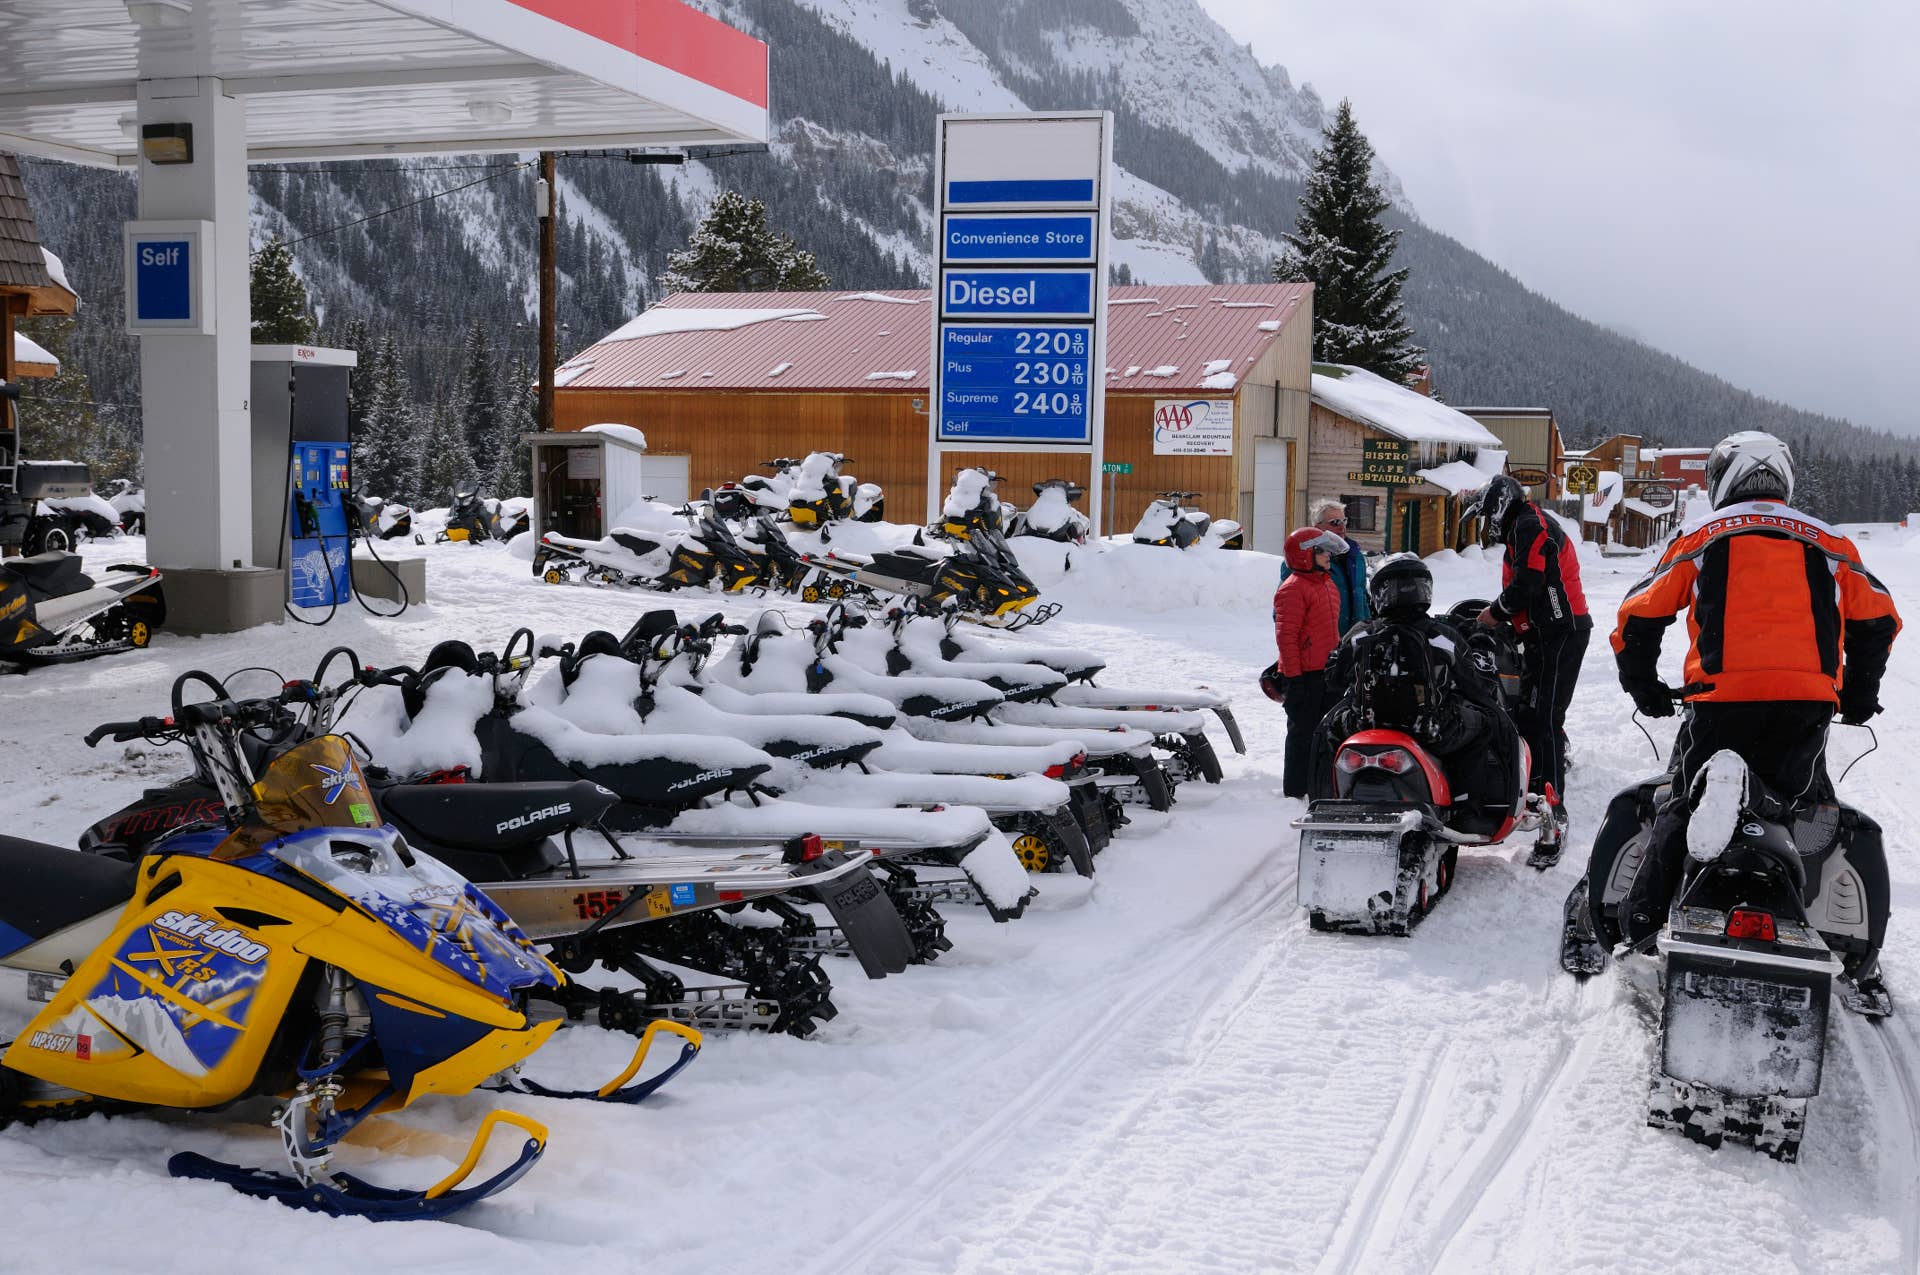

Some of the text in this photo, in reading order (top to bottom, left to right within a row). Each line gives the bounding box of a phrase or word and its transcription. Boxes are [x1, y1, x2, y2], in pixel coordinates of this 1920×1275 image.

[951, 231, 1084, 245] Convenience Store
[142, 248, 180, 266] Self
[949, 280, 1036, 305] Diesel
[948, 332, 993, 346] Regular
[1014, 332, 1070, 355] 220
[297, 348, 315, 359] EXXON
[947, 362, 972, 373] Plus
[1013, 362, 1069, 385] 230
[243, 400, 248, 410] 2
[946, 392, 999, 405] Supreme
[1013, 392, 1069, 415] 240
[1157, 404, 1190, 431] AAA
[946, 420, 969, 432] Self
[1376, 441, 1399, 450] THE
[1365, 451, 1409, 461] BISTRO
[1102, 463, 1121, 473] ATON
[1369, 464, 1404, 473] CAFE
[1349, 472, 1424, 485] RESTAURANT
[1708, 515, 1819, 539] POLARIS
[496, 802, 572, 834] POLARIS
[31, 1031, 73, 1053] HP3697
[77, 1042, 89, 1054] 09
